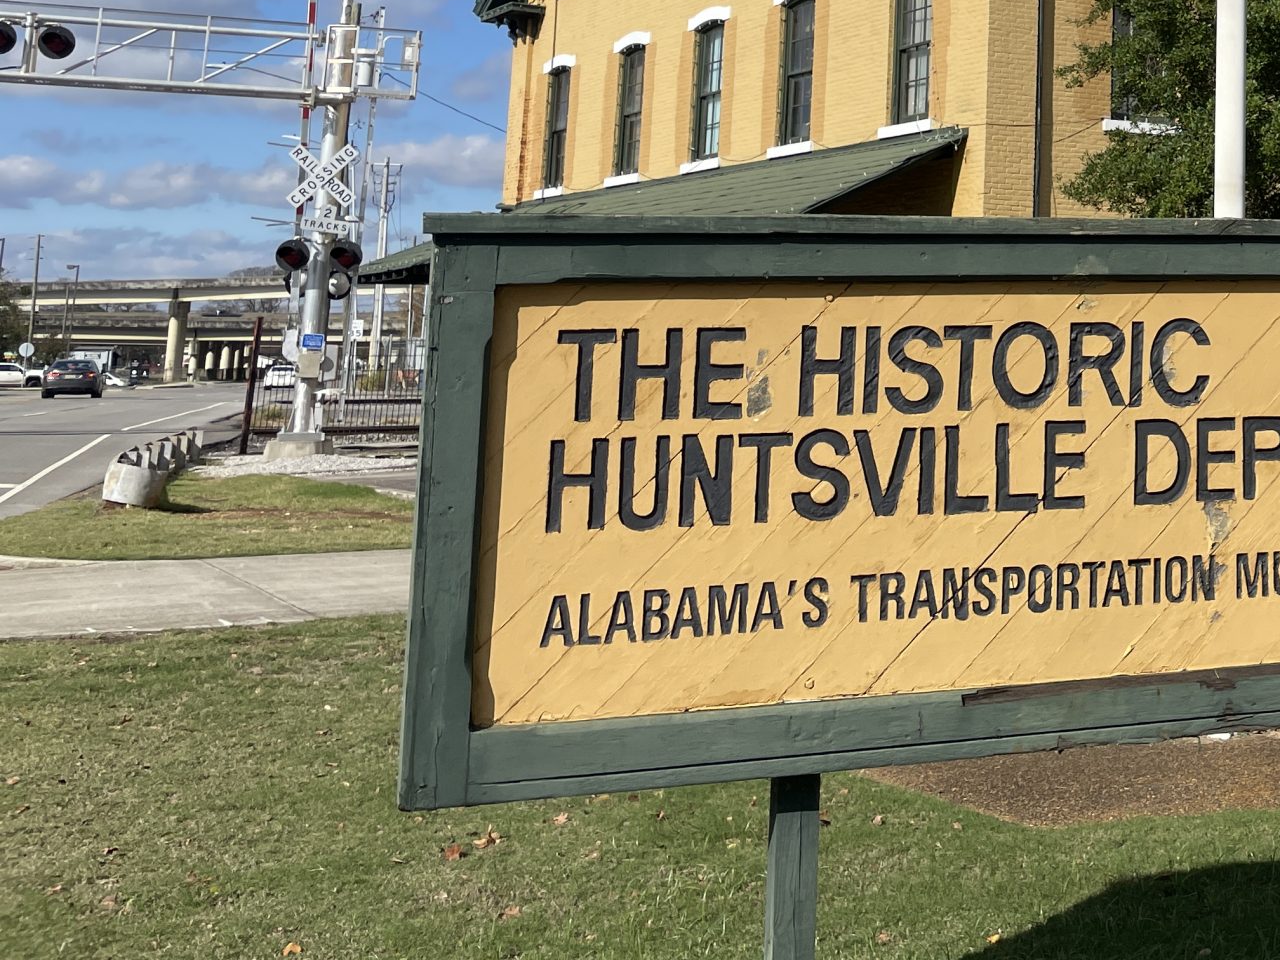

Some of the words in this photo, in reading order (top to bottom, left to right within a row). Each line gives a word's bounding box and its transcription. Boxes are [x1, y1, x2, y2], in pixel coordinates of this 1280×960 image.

[290, 148, 354, 204] CROSSING
[324, 208, 333, 219] 2
[303, 219, 347, 232] TRACKS
[557, 326, 747, 422] THE
[800, 318, 1211, 417] HISTORIC
[545, 420, 1087, 533] HUNTSVILLE
[540, 577, 829, 648] ALABAMA'S
[851, 554, 1217, 623] TRANSPORTATION
